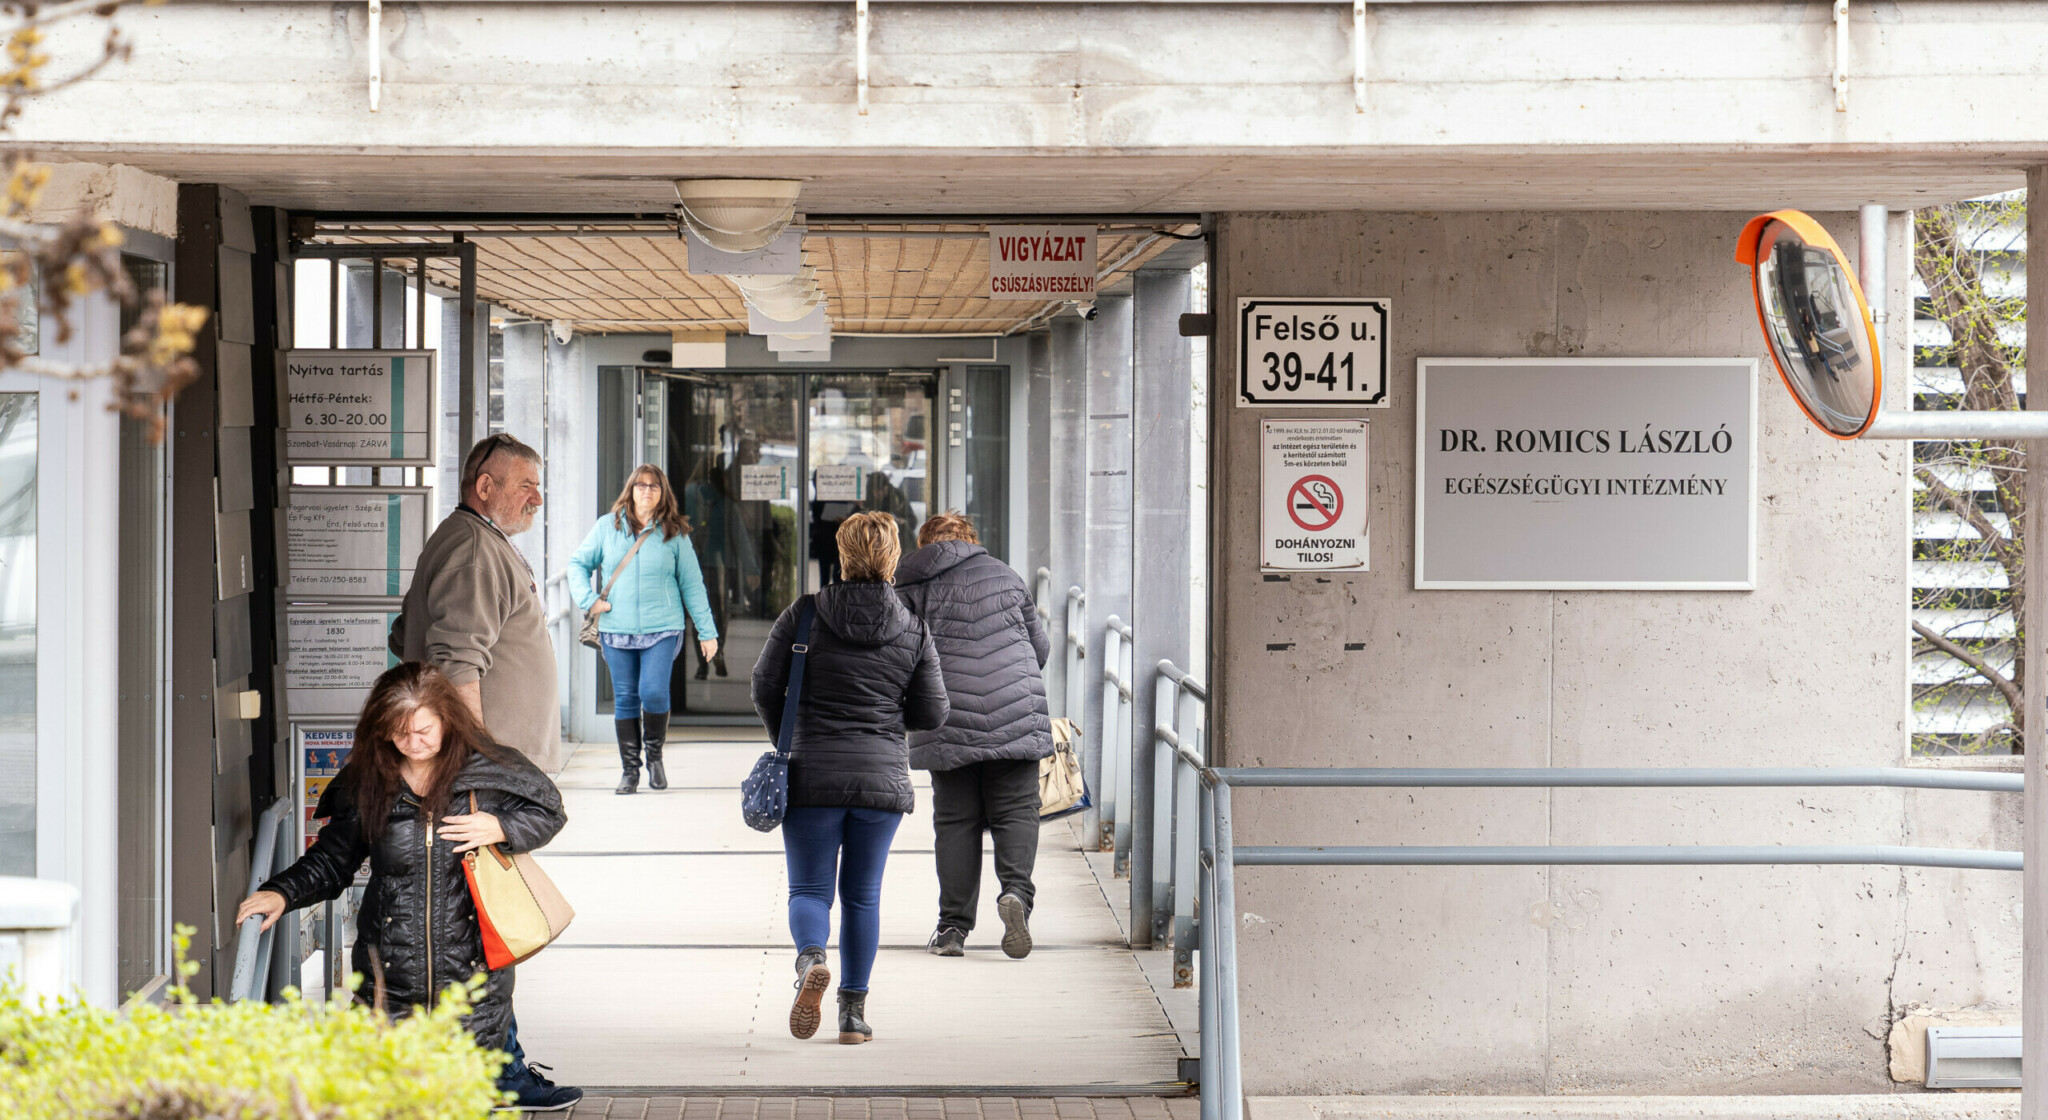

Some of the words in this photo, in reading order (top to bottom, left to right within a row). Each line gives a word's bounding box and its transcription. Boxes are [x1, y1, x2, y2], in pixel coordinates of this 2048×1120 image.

[999, 230, 1086, 261] VIGYÁZAT
[992, 273, 1094, 292] CSÚSZÁSVESZÉLY!
[1255, 315, 1340, 341] Felső
[1351, 321, 1376, 341] u.
[289, 364, 334, 379] Nyitva
[340, 363, 383, 376] tartás
[1262, 351, 1368, 392] 39-41.
[289, 392, 372, 403] Hétfő-Péntek:
[305, 413, 387, 425] 6.30-20.00
[360, 438, 388, 448] ZÁRVA
[1439, 429, 1486, 453] DR.
[1494, 429, 1610, 454] ROMICS
[1618, 423, 1732, 454] LÁSZLÓ
[1302, 443, 1320, 451] egész
[1444, 474, 1600, 495] EGÉSZSÉGÜGYI
[1606, 474, 1728, 495] INTÉZMÉNY
[323, 504, 349, 512] ügyelet
[354, 504, 372, 512] Szép
[300, 514, 311, 523] Fog
[1275, 537, 1355, 549] DOHÁNYOZNI
[1297, 553, 1333, 563] TILOS!
[326, 627, 345, 635] 1830
[305, 732, 344, 740] KEDVES
